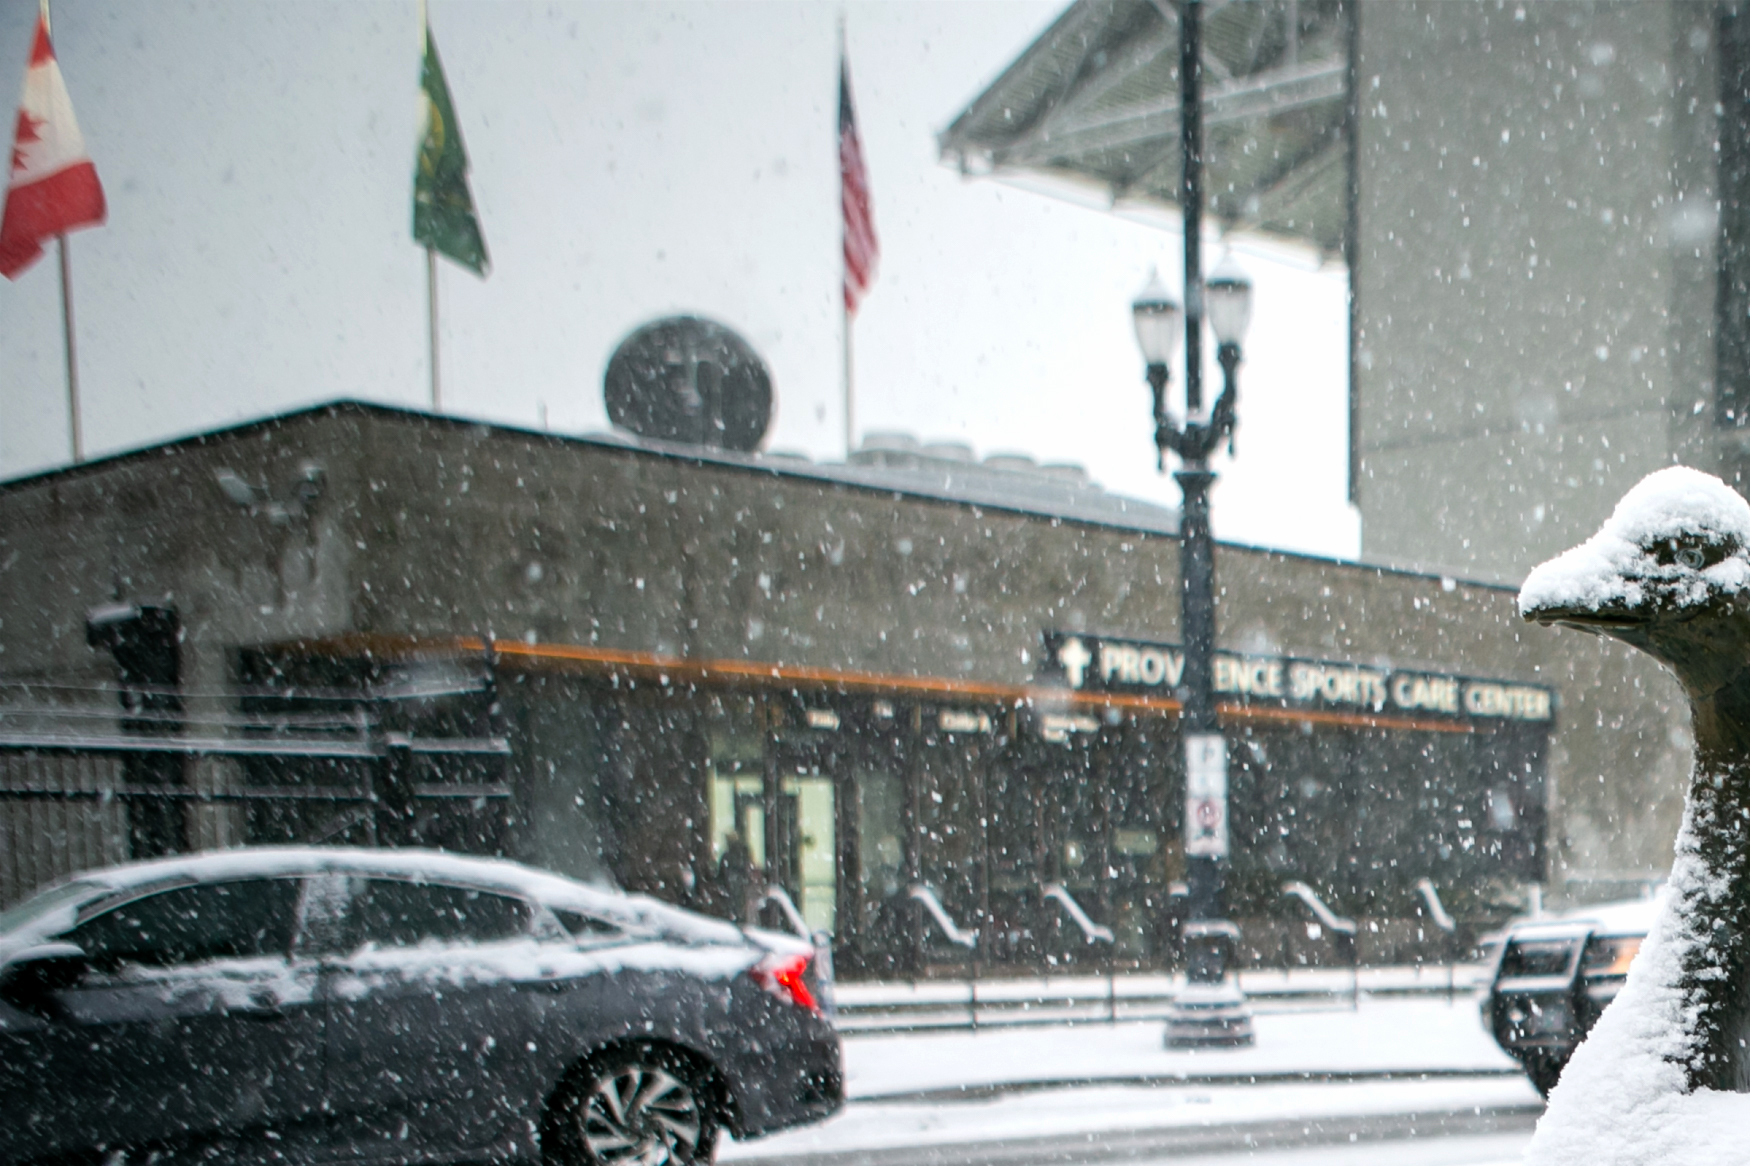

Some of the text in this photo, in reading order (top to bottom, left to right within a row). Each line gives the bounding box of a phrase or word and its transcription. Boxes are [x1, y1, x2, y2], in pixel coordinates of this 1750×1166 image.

[1101, 644, 1551, 720] PROVENCE SPORTS CARE CENTER
